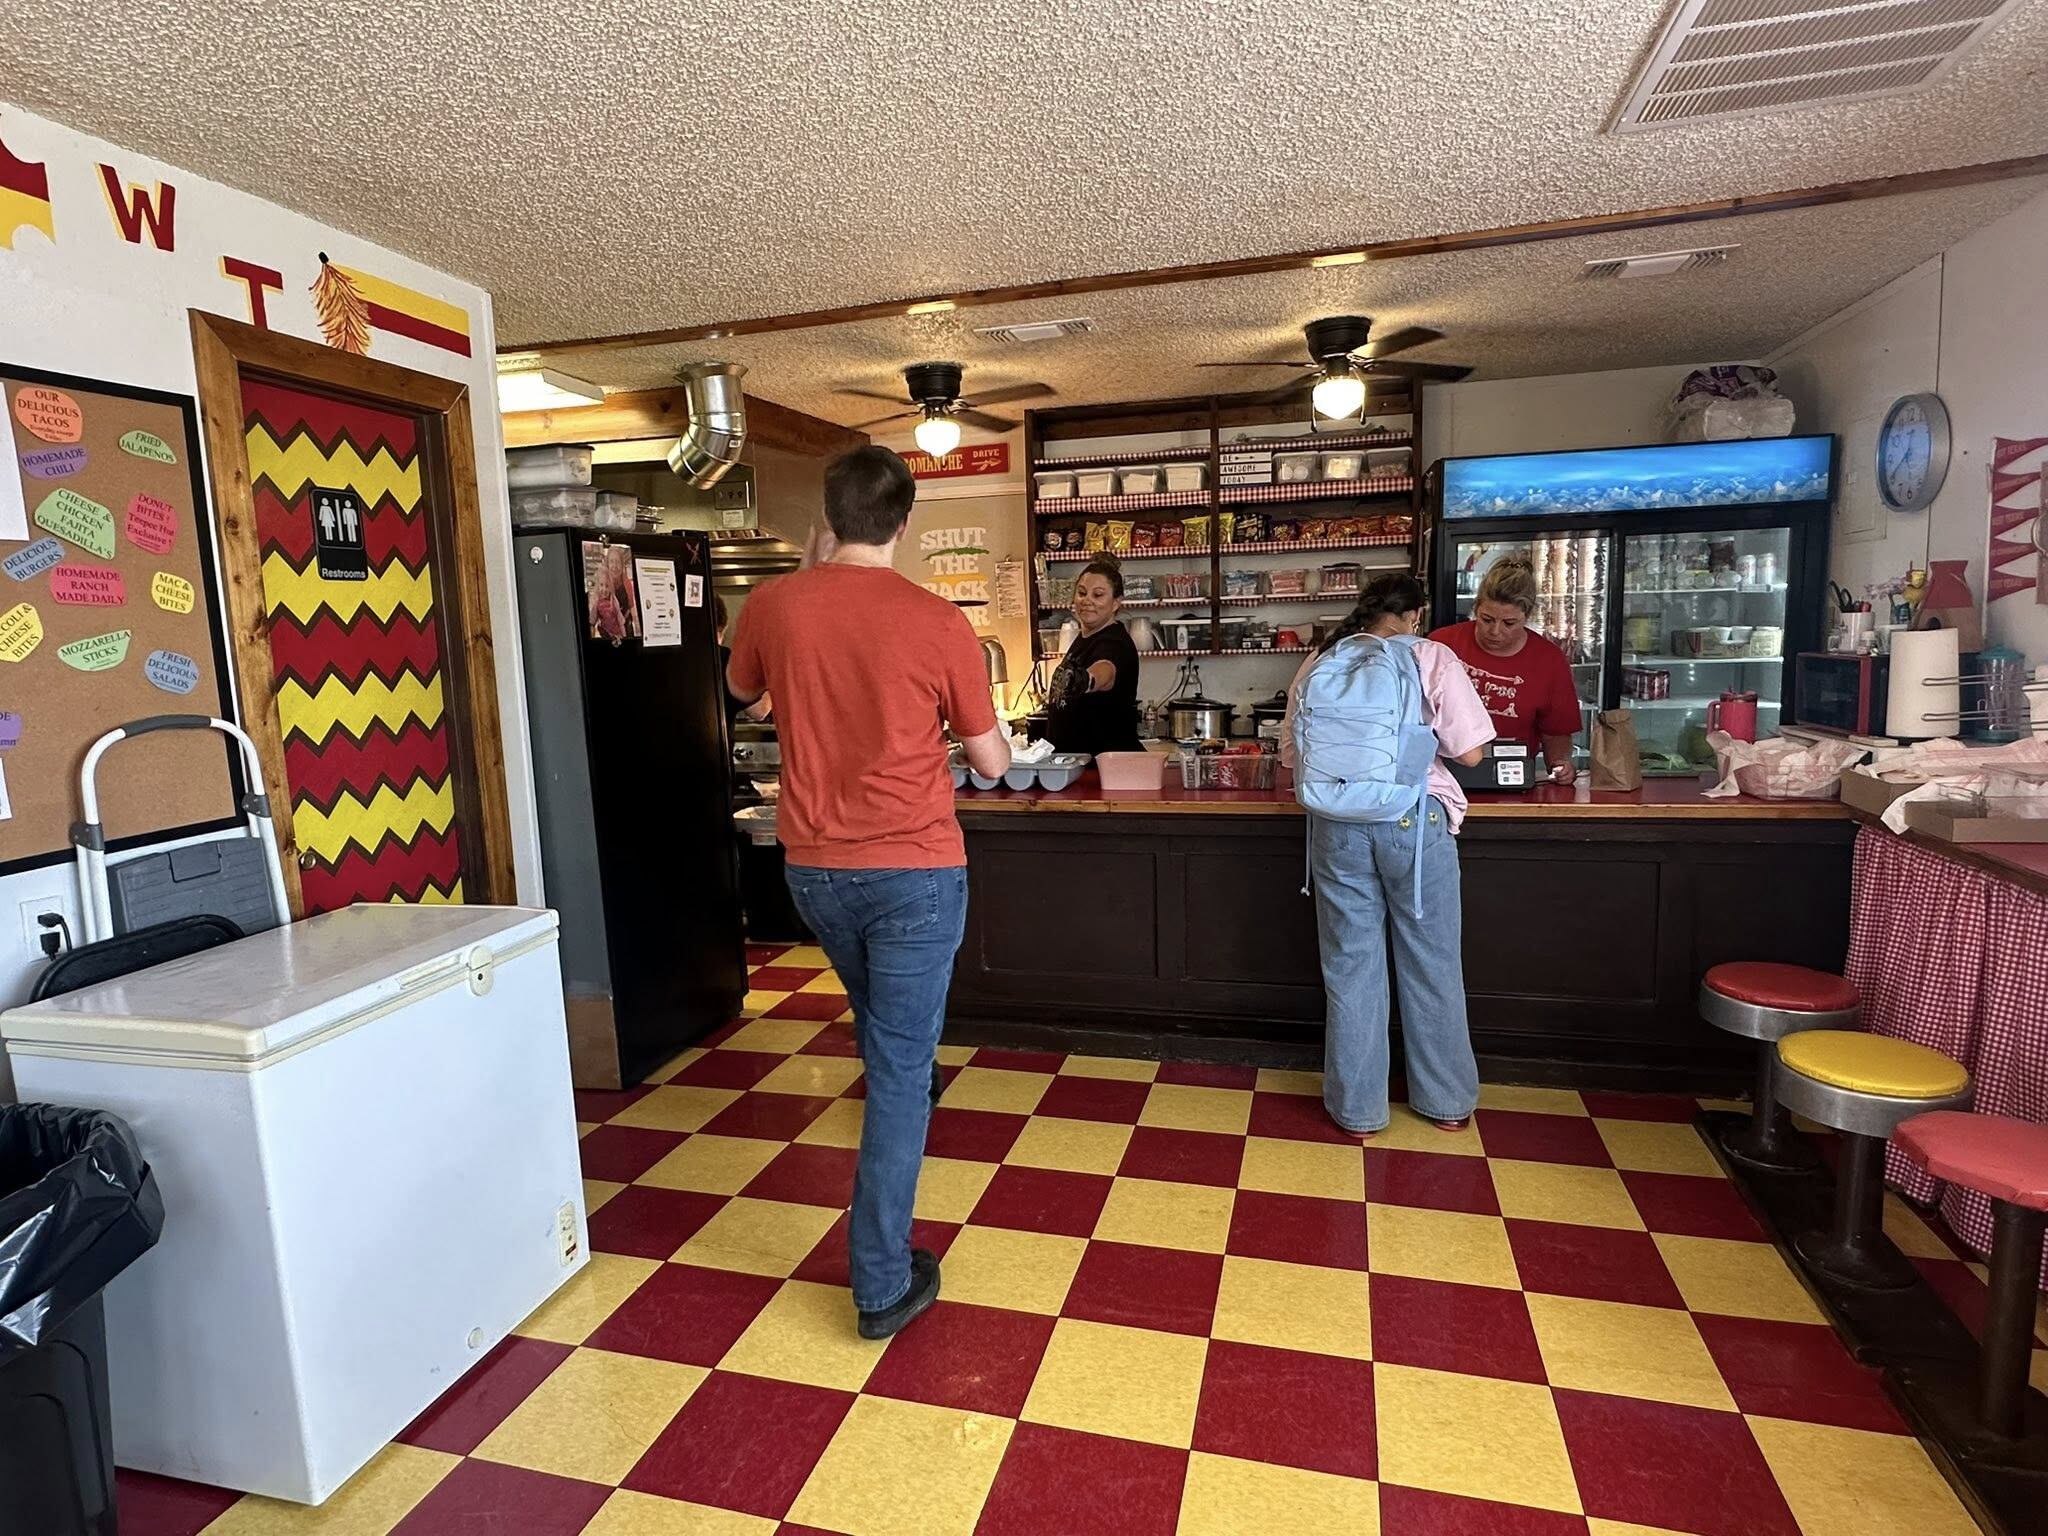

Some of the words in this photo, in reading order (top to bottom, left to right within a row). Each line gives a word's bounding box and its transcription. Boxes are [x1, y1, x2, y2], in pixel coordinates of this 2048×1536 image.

[95, 162, 176, 252] W
[219, 255, 283, 330] T
[34, 389, 59, 402] OUR
[17, 398, 80, 418] DELICIOUS
[31, 414, 70, 428] TACOS
[135, 432, 162, 448] FRIED
[22, 448, 86, 467] HOMEMADE
[972, 448, 1000, 459] DRIVE
[45, 463, 75, 476] CHILI
[1222, 464, 1256, 473] AWESOME
[1223, 475, 1246, 484] TODAY
[58, 489, 100, 515] CHEESE
[102, 512, 112, 523] &
[138, 492, 174, 512] DONUT
[56, 501, 104, 530] CHICKEN
[37, 514, 113, 558] QUESADILLA'S
[60, 514, 96, 539] FAJITA
[920, 527, 987, 550] SHUT
[4, 538, 58, 570] DELICIOUS
[14, 551, 63, 580] BURGERS
[56, 567, 121, 581] HOMEMADE
[321, 567, 366, 579] Restrooms
[929, 553, 979, 576] THE
[71, 580, 109, 592] RANCH
[159, 573, 182, 588] MAC
[182, 582, 190, 591] &
[56, 591, 91, 603] MADE
[92, 593, 125, 605] DAILY
[155, 584, 192, 602] CHEESE
[159, 596, 187, 611] BITES
[0, 610, 26, 637] COLI
[22, 604, 33, 614] &
[0, 620, 34, 653] CHEESE
[12, 633, 40, 658] BITES
[60, 631, 131, 658] MOZZARELLA
[82, 645, 119, 663] STICKS
[161, 651, 192, 668] FRESH
[147, 658, 198, 681] DELICIOUS
[152, 671, 190, 689] SALADS
